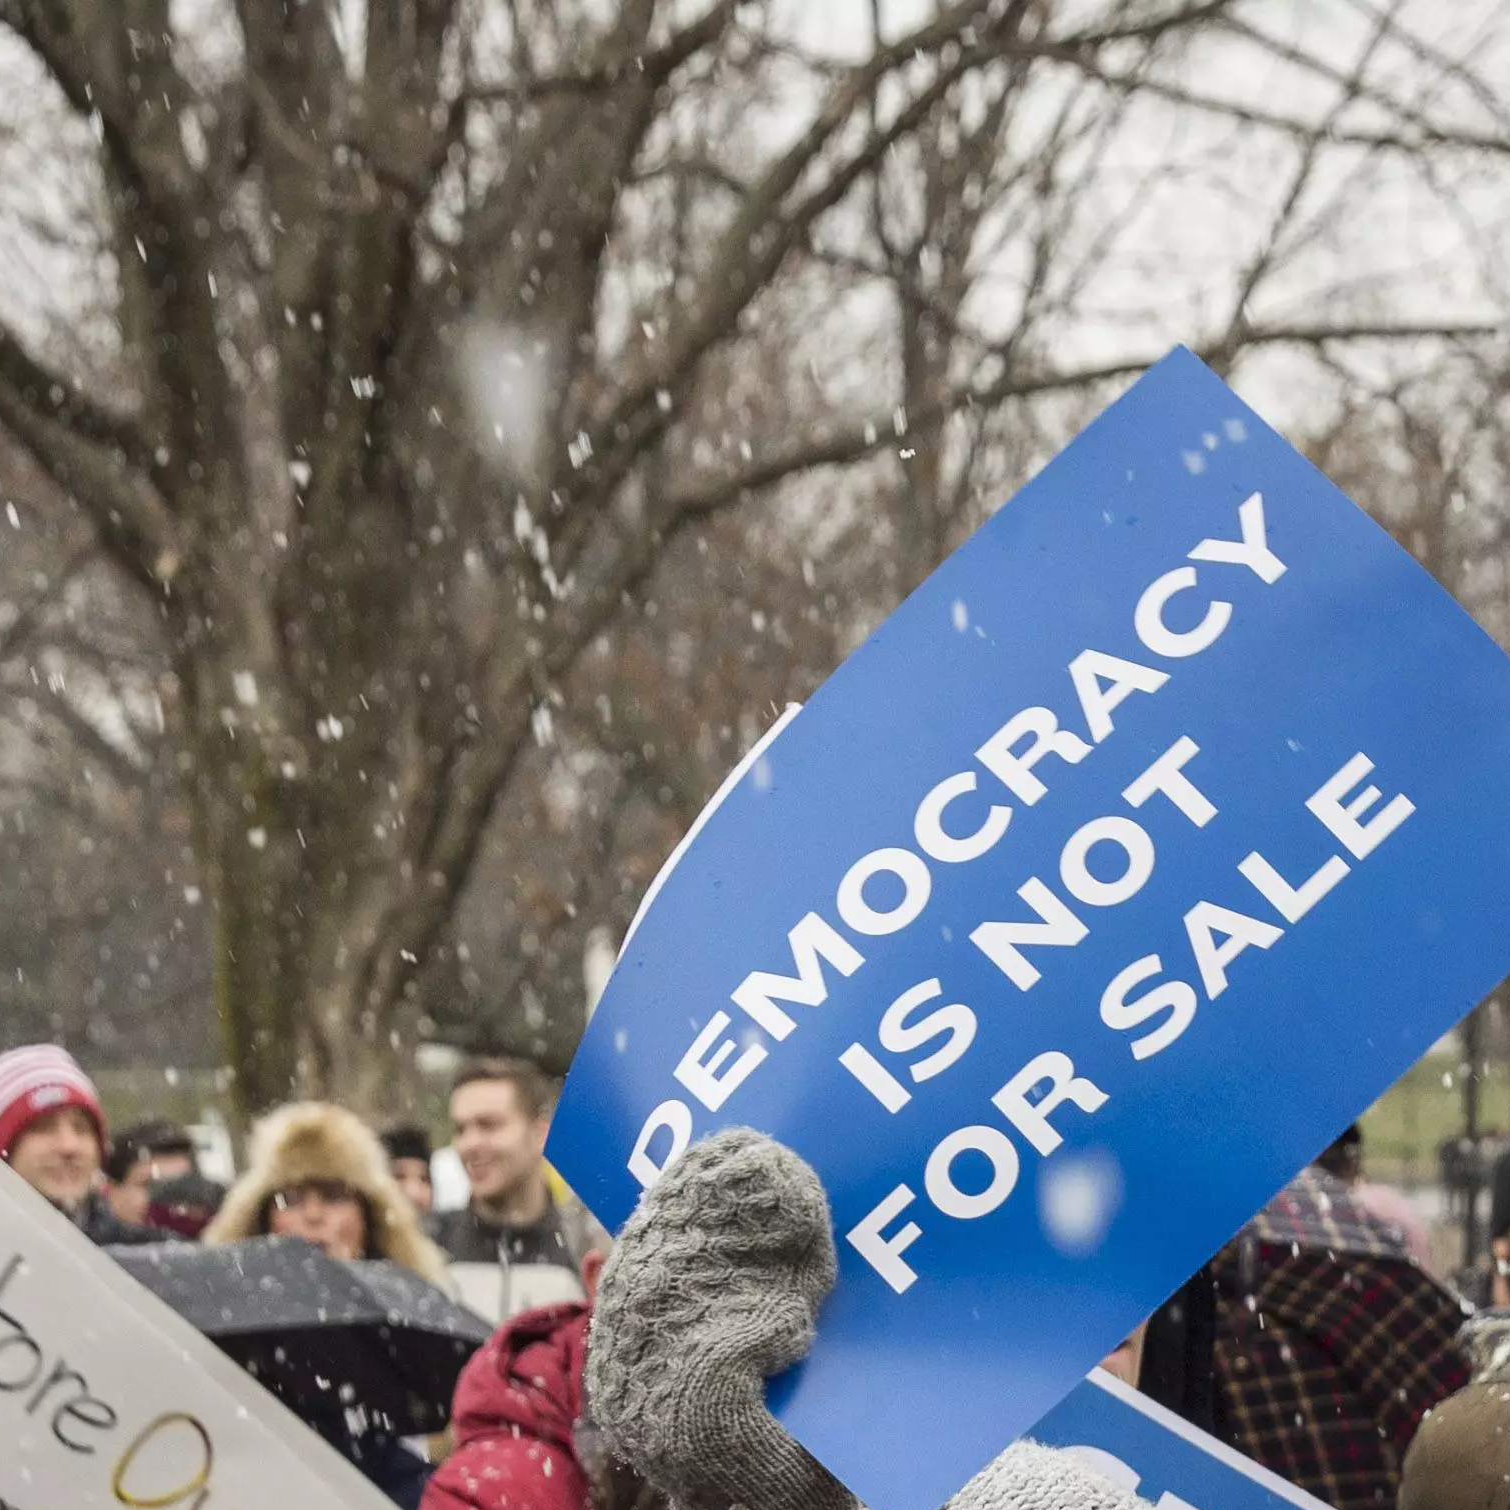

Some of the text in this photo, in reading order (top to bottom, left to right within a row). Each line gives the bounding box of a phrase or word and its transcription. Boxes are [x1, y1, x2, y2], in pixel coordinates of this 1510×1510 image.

[627, 492, 1287, 1196] DEMOCRACY
[838, 736, 1220, 1114] IS NOT
[846, 752, 1416, 1293] FOR SALE
